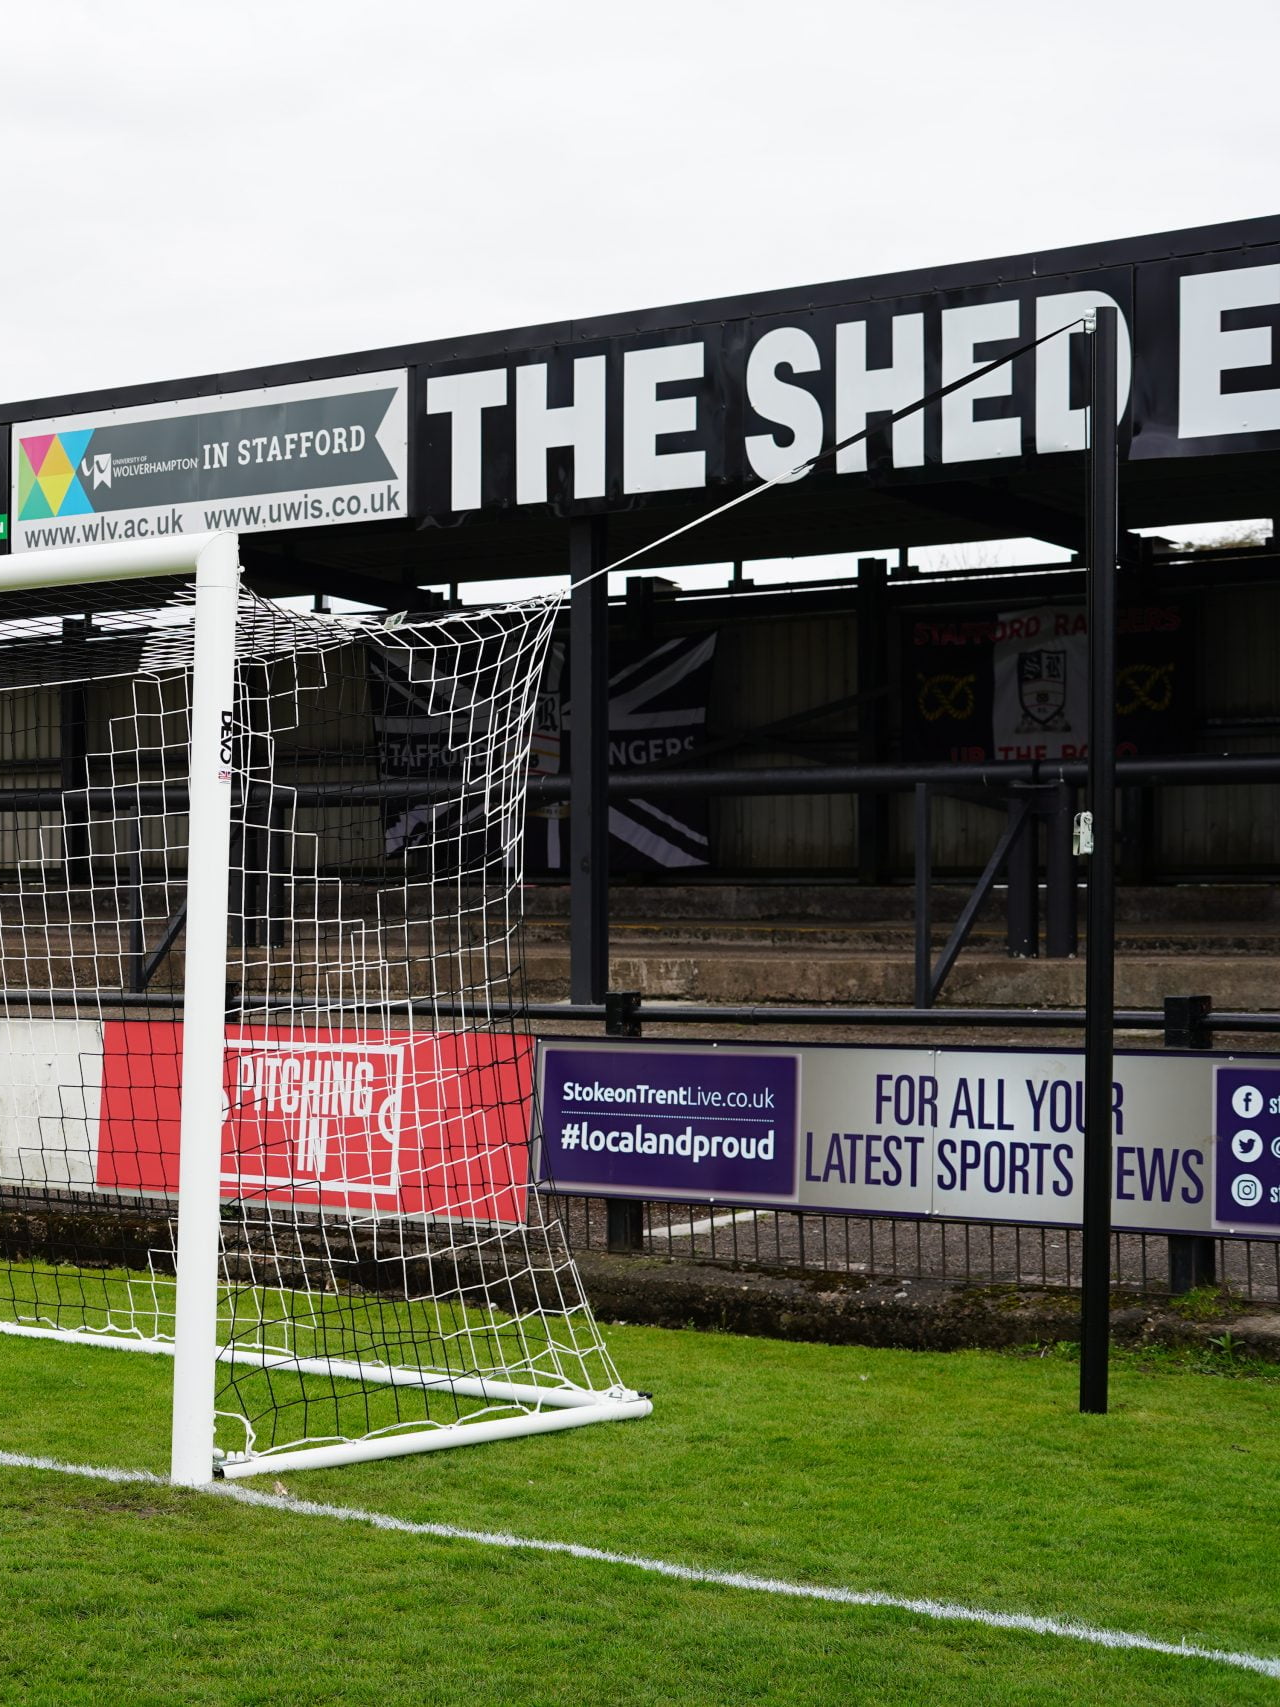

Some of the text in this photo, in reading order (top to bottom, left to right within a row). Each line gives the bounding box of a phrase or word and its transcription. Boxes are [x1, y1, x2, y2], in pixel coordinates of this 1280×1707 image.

[425, 341, 707, 512] THE
[744, 289, 1132, 484] SHED
[112, 456, 139, 465] UNIVERSITY
[113, 459, 198, 478] WOLVERHAMPTON
[203, 425, 365, 470] IN STAFFORD
[25, 509, 183, 548] www.wlv.ac.uk
[204, 485, 401, 530] www.uwis.co.uk
[912, 615, 1041, 647] STAFFORD
[235, 1056, 374, 1117] PITCHING
[563, 1081, 775, 1109] StokeonTrentLive.co.uk
[875, 1074, 938, 1127] FOR
[949, 1077, 1014, 1131] ALL
[297, 1113, 329, 1173] IN
[561, 1121, 775, 1163] #localandproud
[805, 1131, 1204, 1204] LATEST SPORTS EWS
